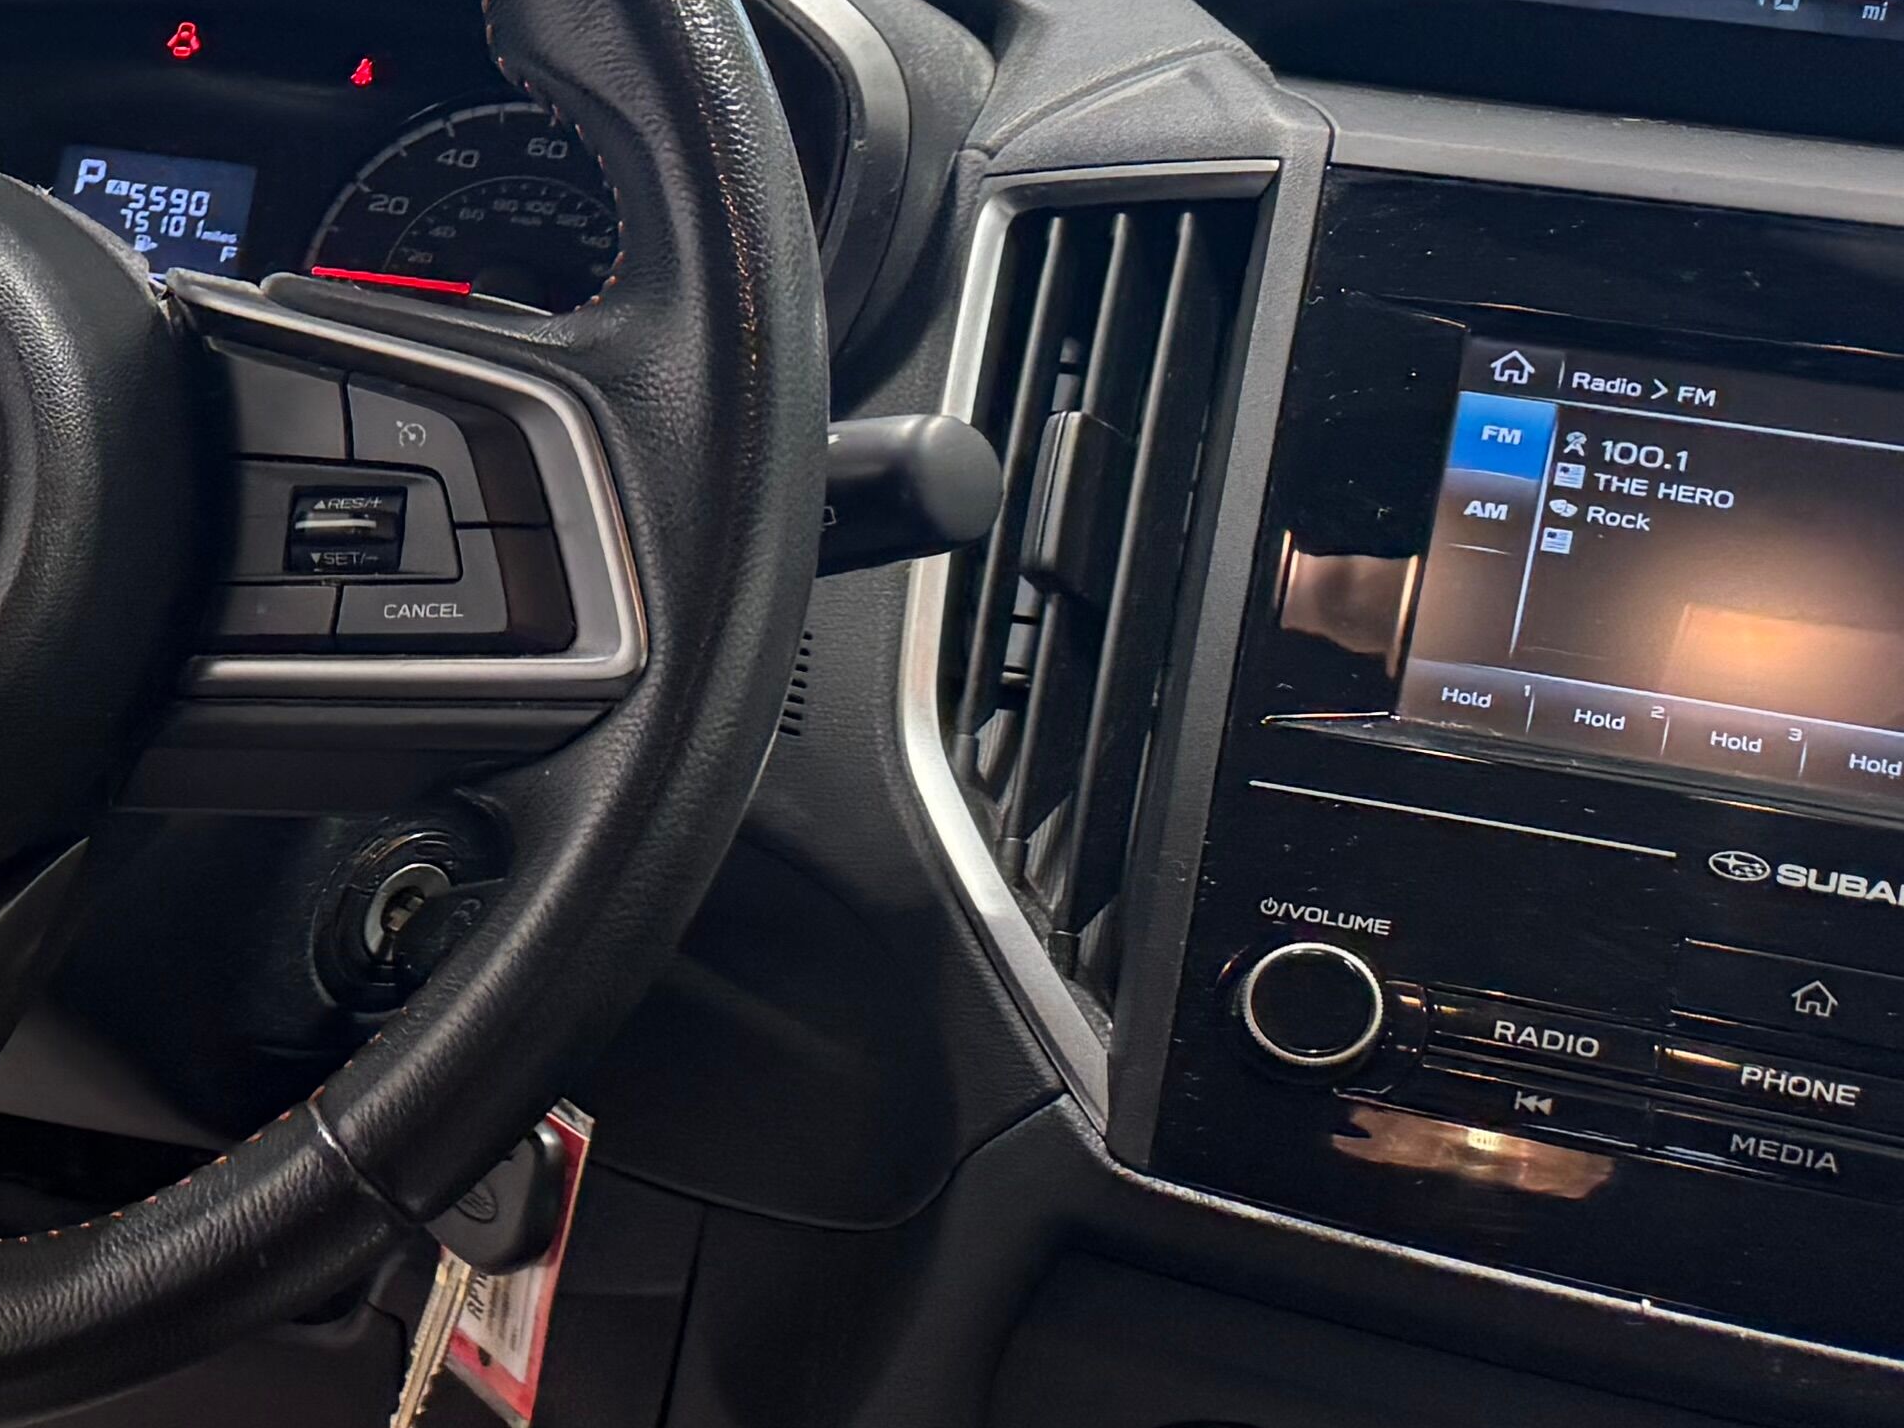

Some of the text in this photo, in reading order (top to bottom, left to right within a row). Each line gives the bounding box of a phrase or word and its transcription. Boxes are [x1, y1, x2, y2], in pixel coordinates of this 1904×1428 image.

[1862, 0, 1888, 21] mi
[437, 148, 481, 169] 40
[527, 137, 568, 159] 60
[73, 158, 107, 195] P
[368, 193, 409, 215] 20
[220, 246, 238, 262] F
[1572, 372, 1717, 407] Radio FM
[1481, 425, 1522, 446] FM
[1601, 440, 1689, 472] 100.1
[1594, 473, 1735, 509] THE HERO
[1464, 500, 1509, 521] AM
[1587, 505, 1651, 532] Rock
[384, 603, 464, 619] CANCEL
[1441, 686, 1492, 709] Hold
[1524, 685, 1531, 697] 1
[1574, 708, 1626, 731] Hold
[1651, 706, 1665, 719] 2
[1710, 731, 1762, 754] Hold
[1788, 728, 1802, 741] 3
[1849, 753, 1903, 777] Hold
[1776, 864, 1904, 905] SUBA
[1493, 1019, 1600, 1058] RADIO
[1740, 1065, 1860, 1107] PHONE
[1729, 1133, 1839, 1174] MEDIA
